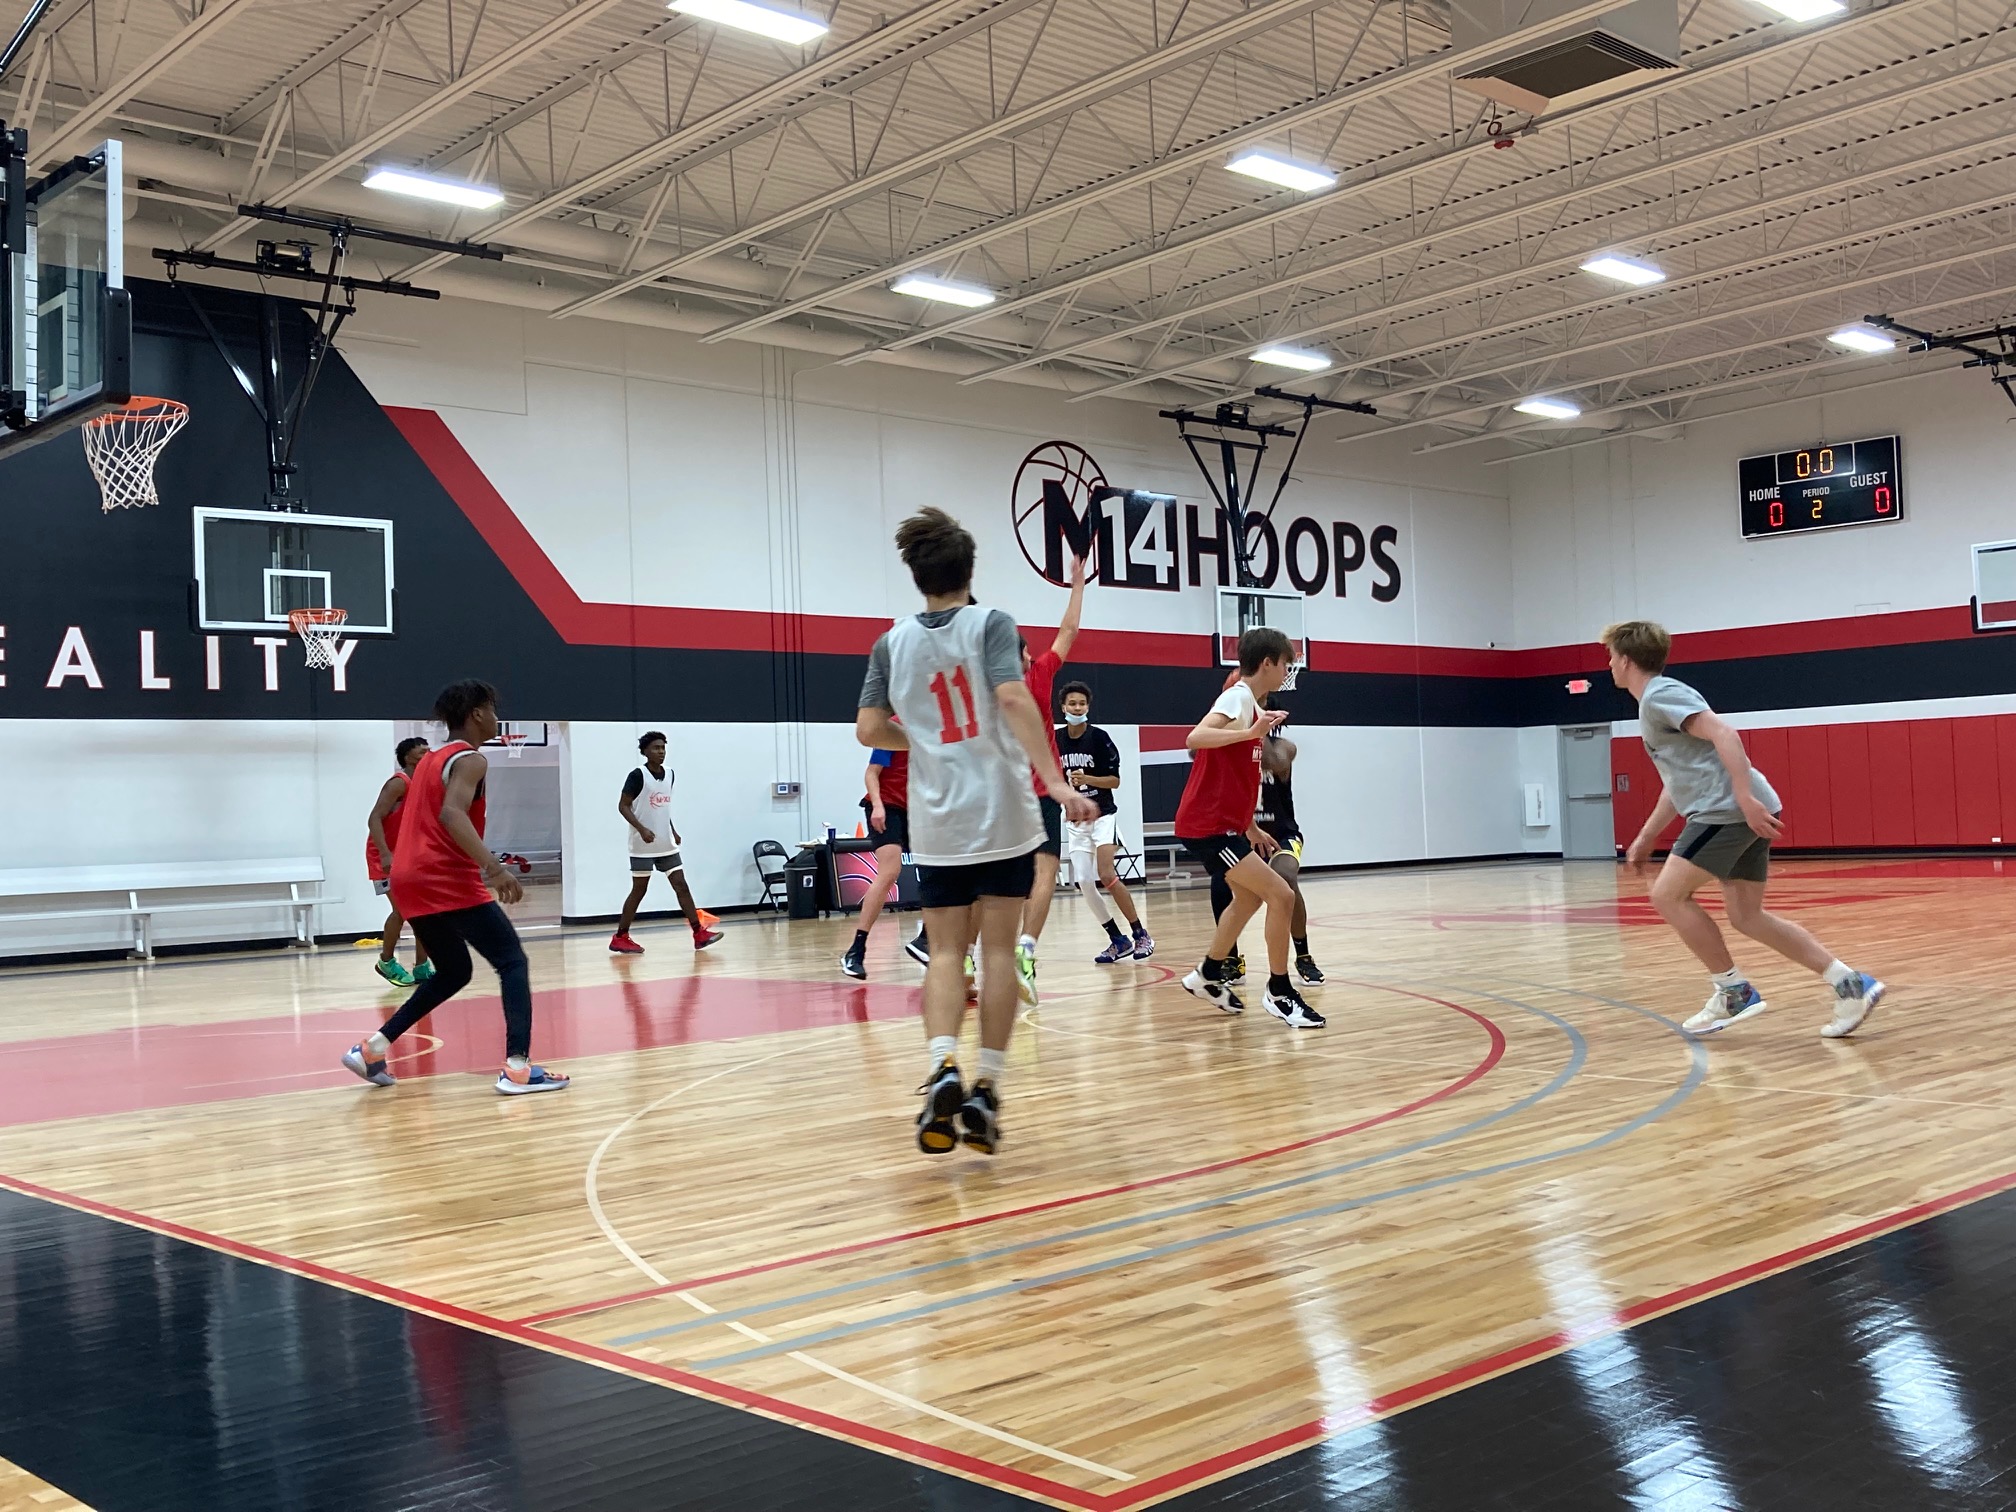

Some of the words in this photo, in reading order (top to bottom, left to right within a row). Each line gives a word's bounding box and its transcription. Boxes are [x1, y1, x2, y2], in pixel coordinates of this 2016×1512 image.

[1796, 449, 1834, 477] 0.0
[1849, 471, 1887, 488] GUEST
[1749, 487, 1781, 502] HOME
[1802, 486, 1830, 498] PERIOD
[1875, 487, 1890, 513] 0
[1769, 502, 1784, 527] 0
[1811, 499, 1823, 519] 2
[0, 625, 359, 692] ALITY
[929, 664, 979, 744] 11
[1069, 752, 1095, 768] HOOPS
